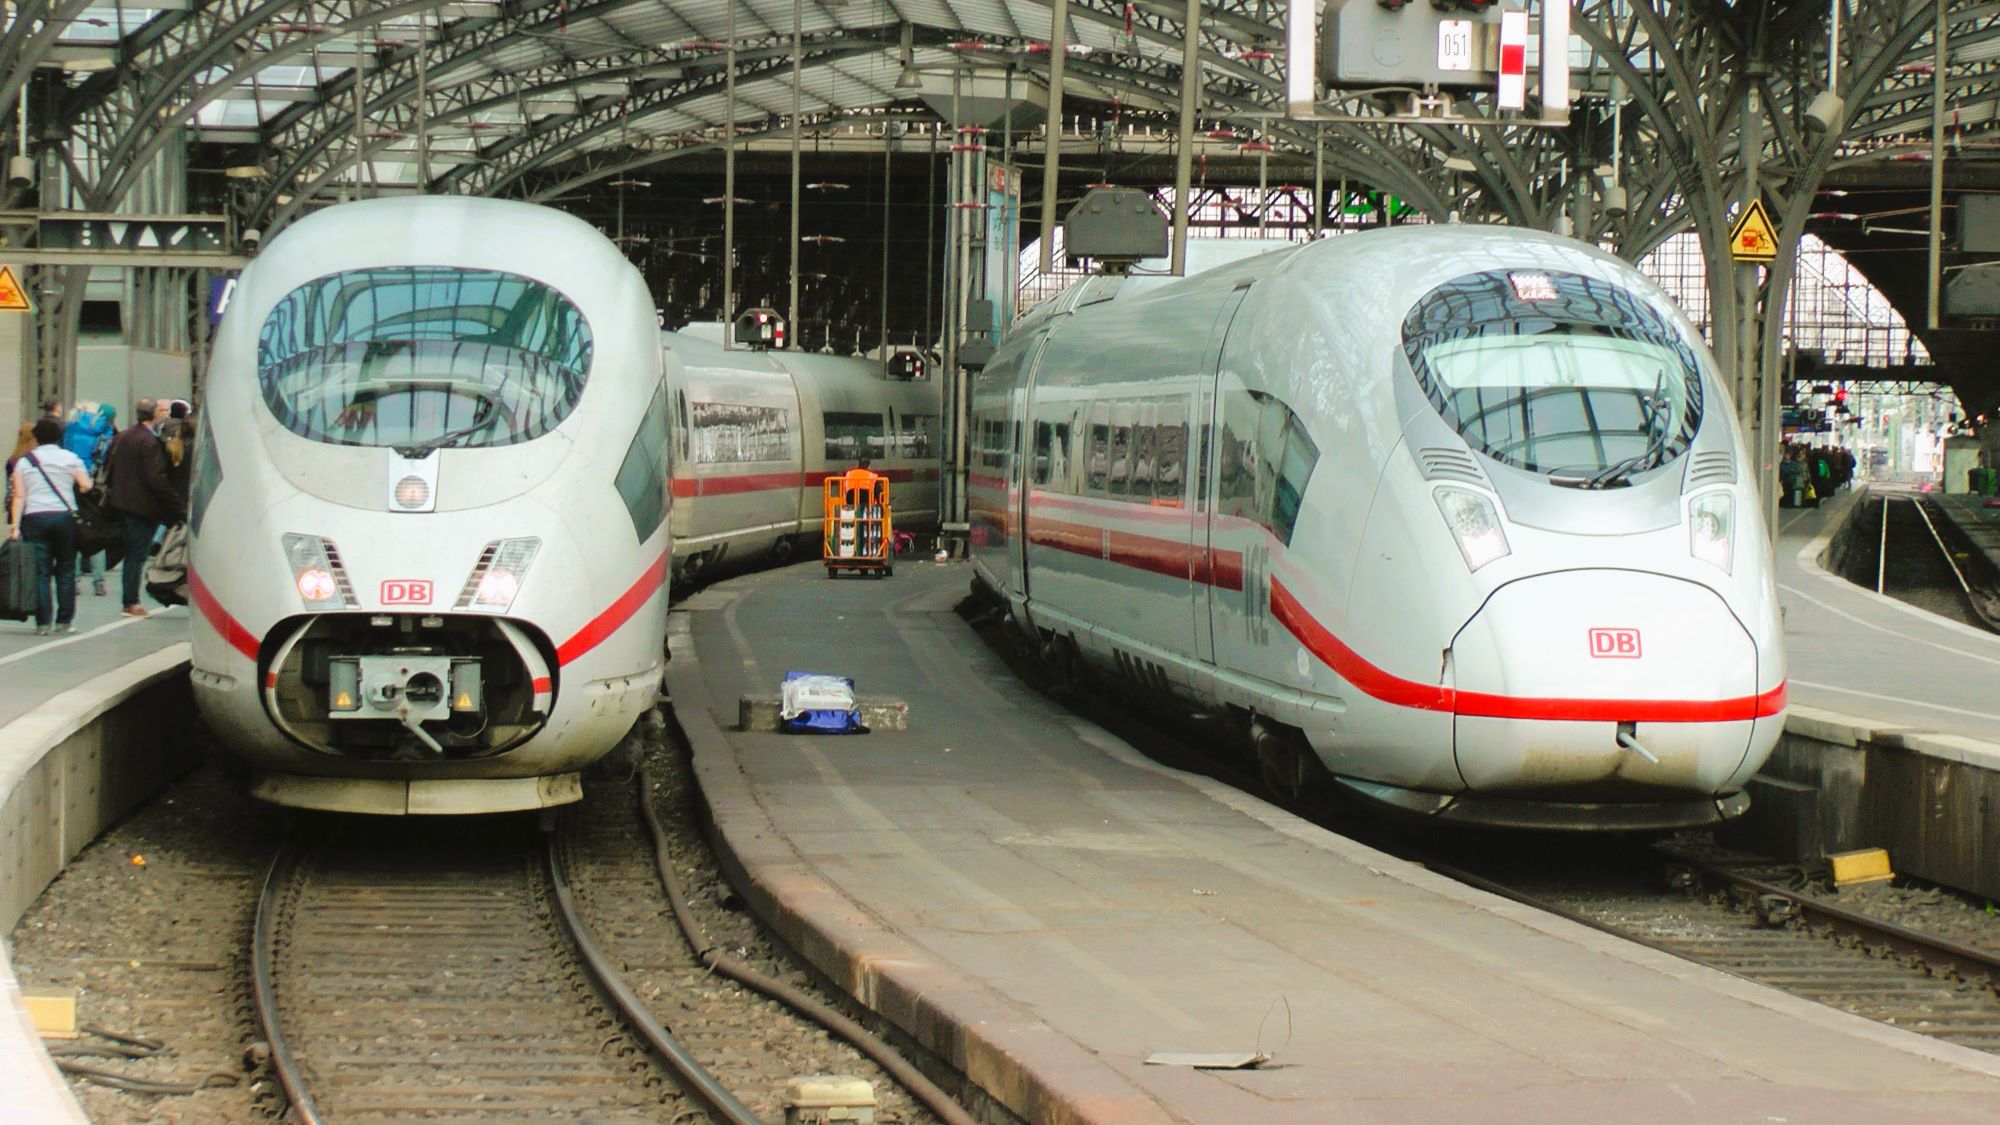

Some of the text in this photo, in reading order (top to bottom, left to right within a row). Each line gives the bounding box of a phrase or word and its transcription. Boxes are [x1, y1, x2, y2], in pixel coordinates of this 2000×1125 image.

[1444, 33, 1466, 56] 051
[386, 583, 428, 602] DB
[1594, 631, 1637, 654] DB
